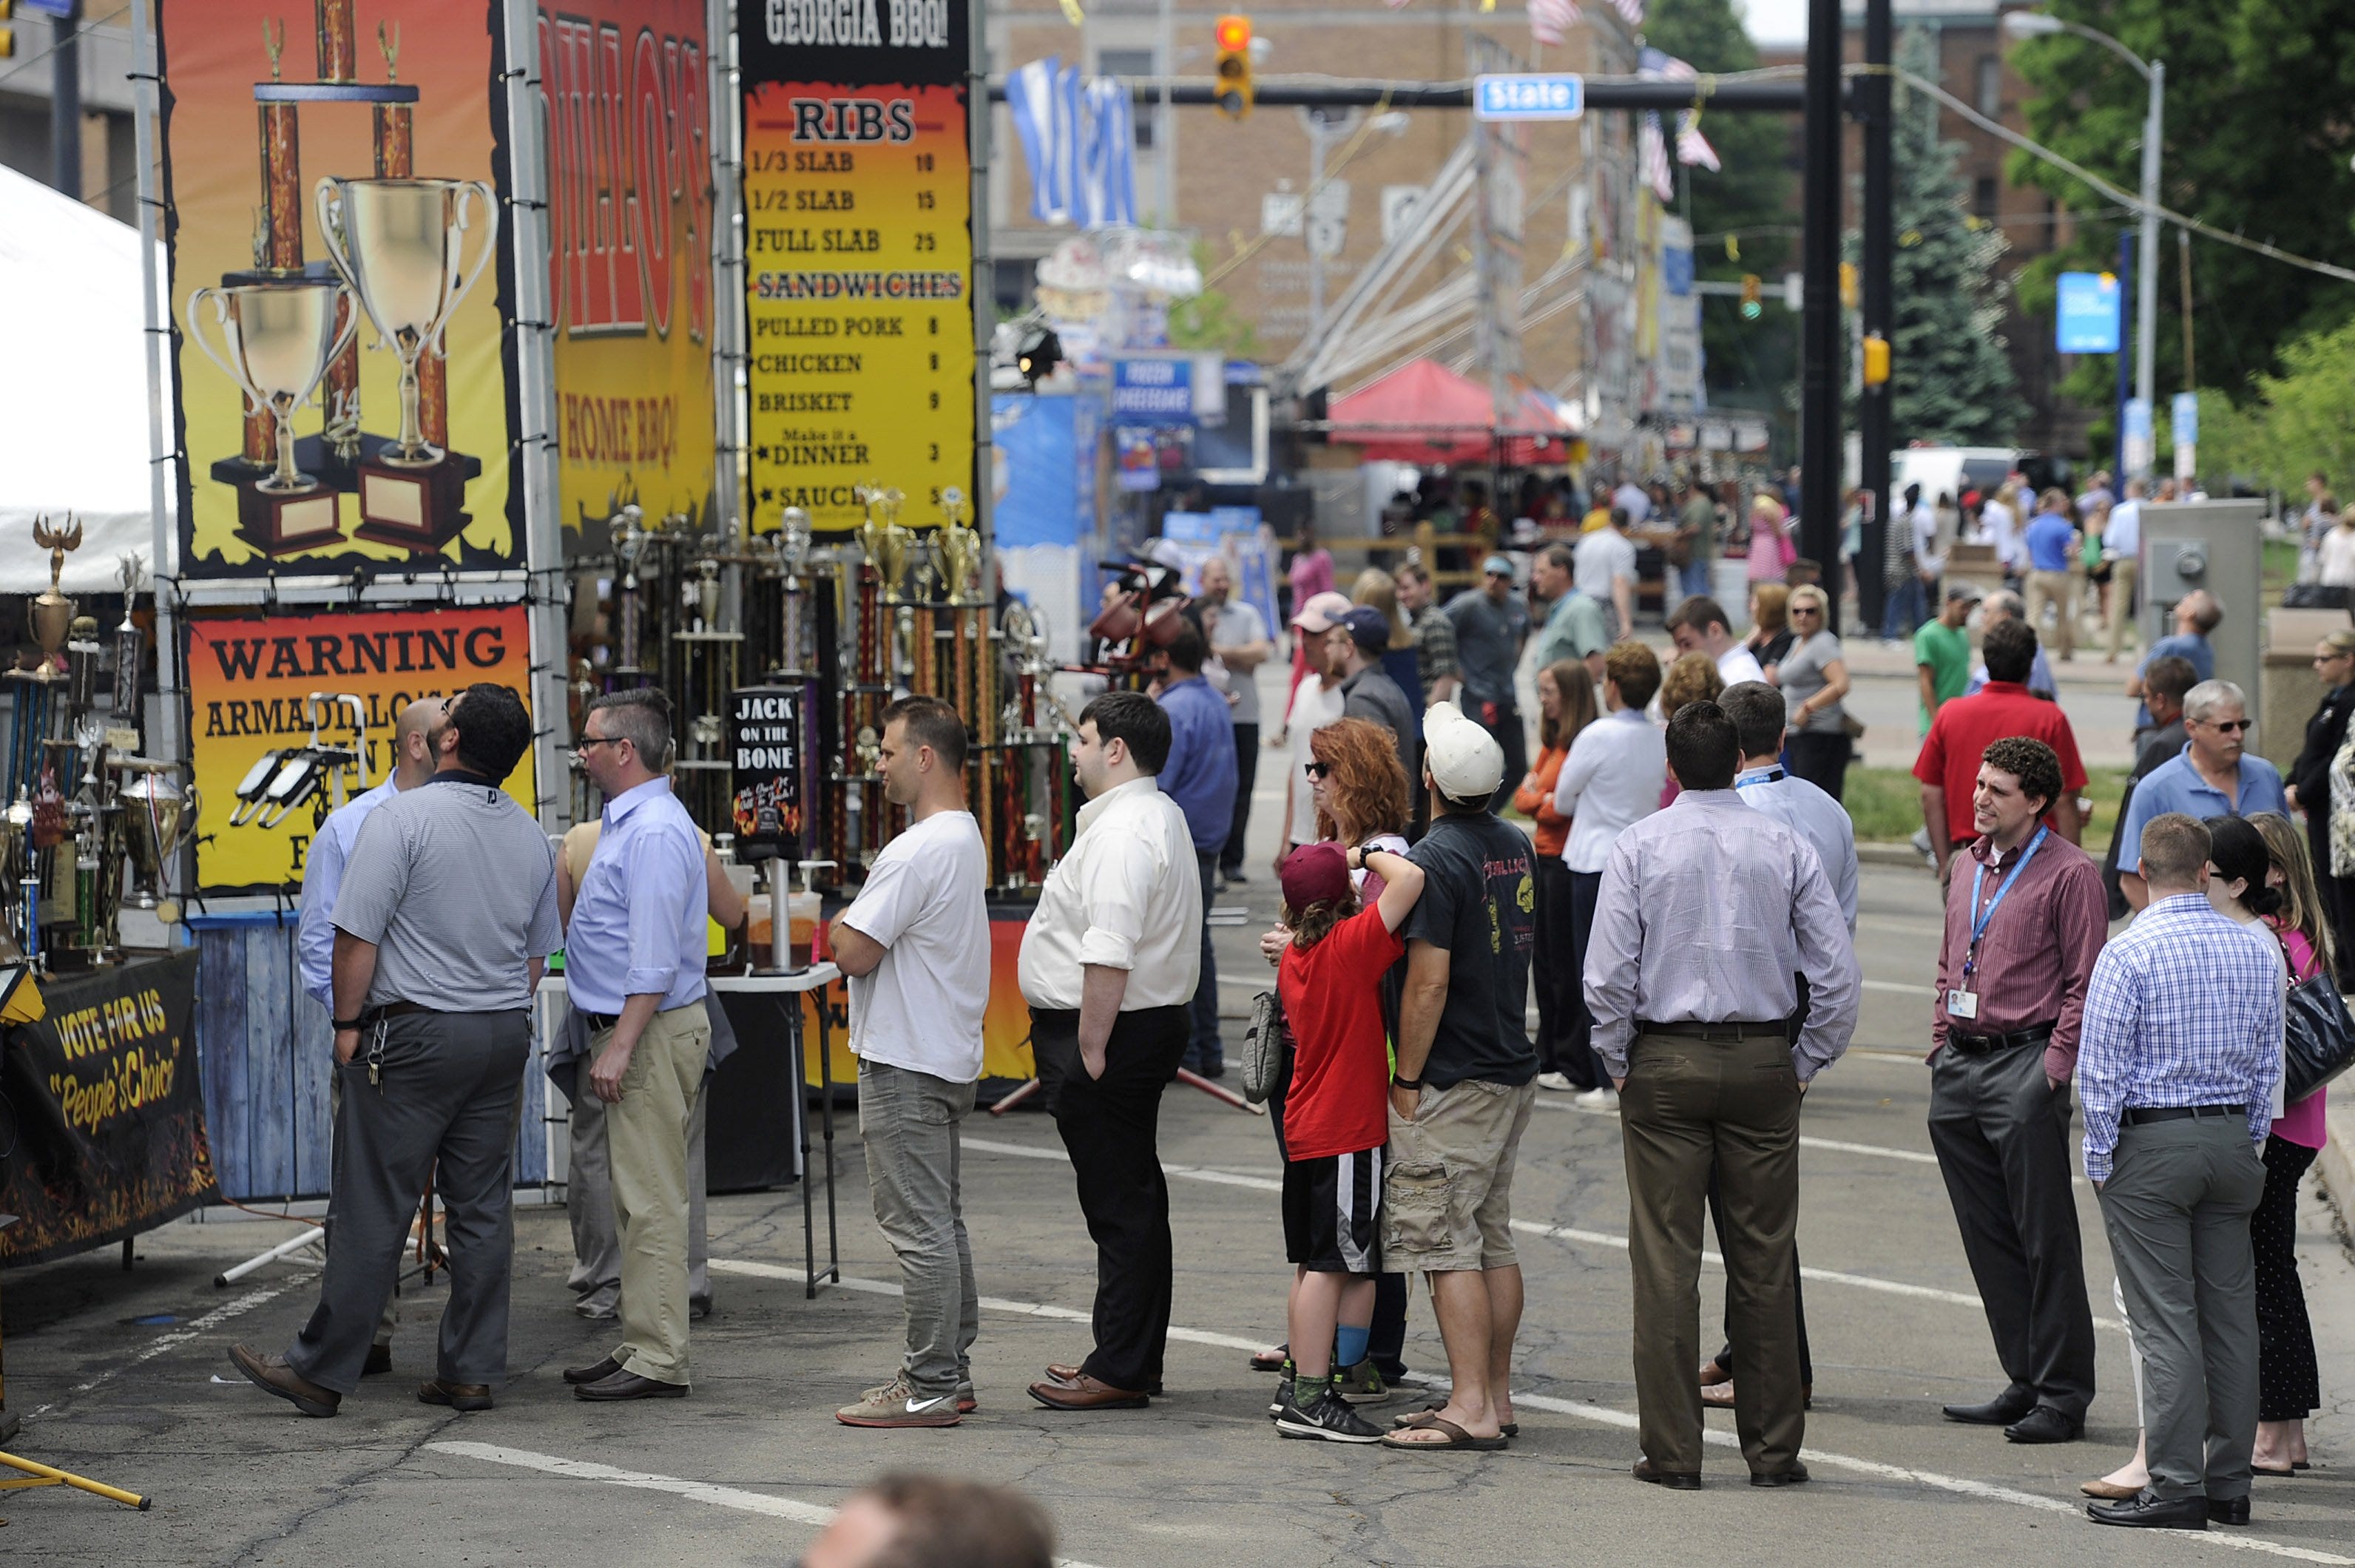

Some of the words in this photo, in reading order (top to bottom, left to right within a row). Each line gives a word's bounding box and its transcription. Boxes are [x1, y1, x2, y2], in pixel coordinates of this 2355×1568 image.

[766, 0, 883, 46] GEORGIA
[1487, 81, 1571, 110] State
[789, 98, 916, 144] RIBS
[751, 151, 788, 172] 1/3
[794, 150, 854, 172] SLAB
[752, 190, 788, 211] 1/2
[795, 189, 854, 211] SLAB
[916, 191, 935, 210] 15
[755, 229, 817, 251] FULL
[822, 228, 880, 251] SLAB
[914, 233, 936, 251] 25
[757, 270, 962, 300] SANDWICHES
[757, 317, 839, 337] PULLED
[845, 317, 904, 335] PORK
[757, 353, 862, 372] CHICKEN
[758, 392, 853, 412] BRISKET
[565, 393, 632, 463] HOME
[783, 428, 827, 442] Make
[774, 445, 869, 465] DINNER
[210, 626, 506, 682] WARNING
[735, 697, 794, 720] JACK
[740, 727, 760, 743] ON
[764, 726, 790, 742] THE
[737, 746, 794, 770] BONE
[54, 1007, 107, 1061] VOTE
[103, 996, 143, 1049] FOR
[137, 988, 166, 1035] US
